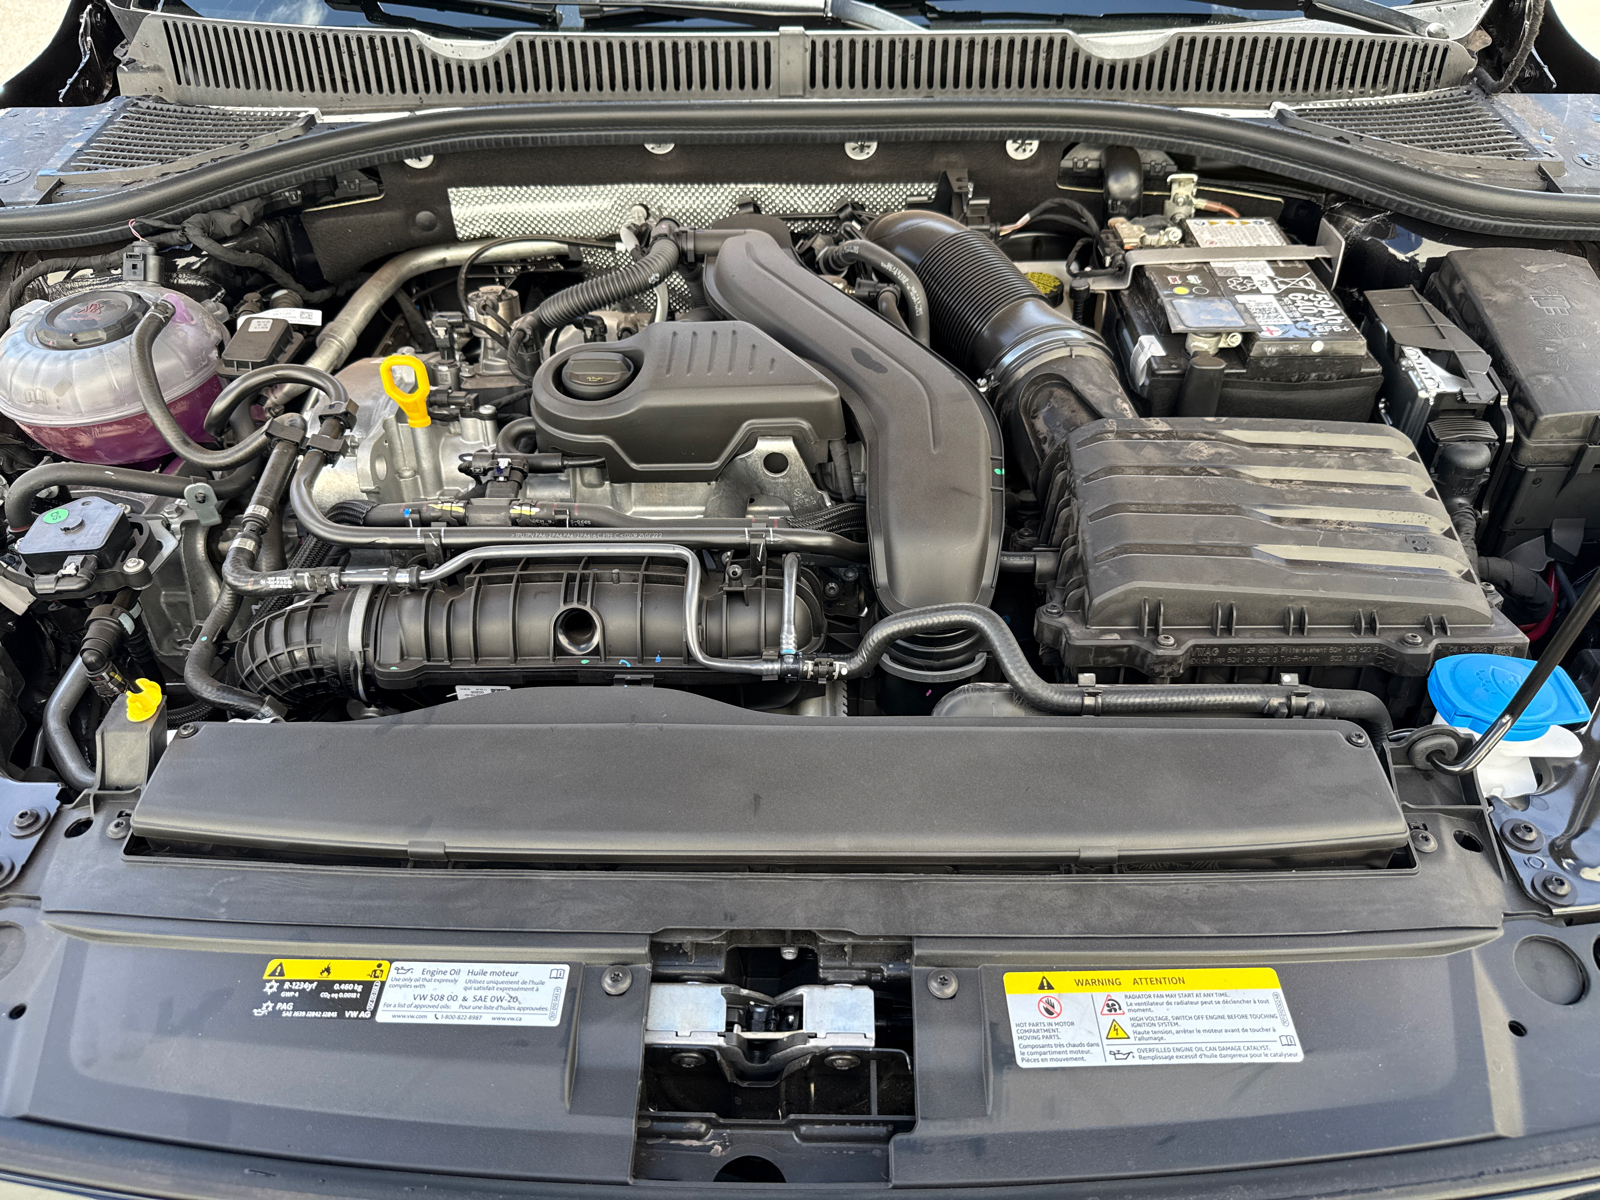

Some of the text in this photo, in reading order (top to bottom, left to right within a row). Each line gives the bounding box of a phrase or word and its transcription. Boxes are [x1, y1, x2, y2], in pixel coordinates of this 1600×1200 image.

[1288, 292, 1319, 314] 640
[1304, 313, 1328, 326] A
[1309, 293, 1344, 325] 59Ah
[1316, 324, 1350, 332] EFB+
[422, 968, 448, 977] Engine
[1074, 977, 1186, 986] WARNING ATTENTION
[283, 982, 318, 992] R-1234yf
[354, 983, 363, 992] kg
